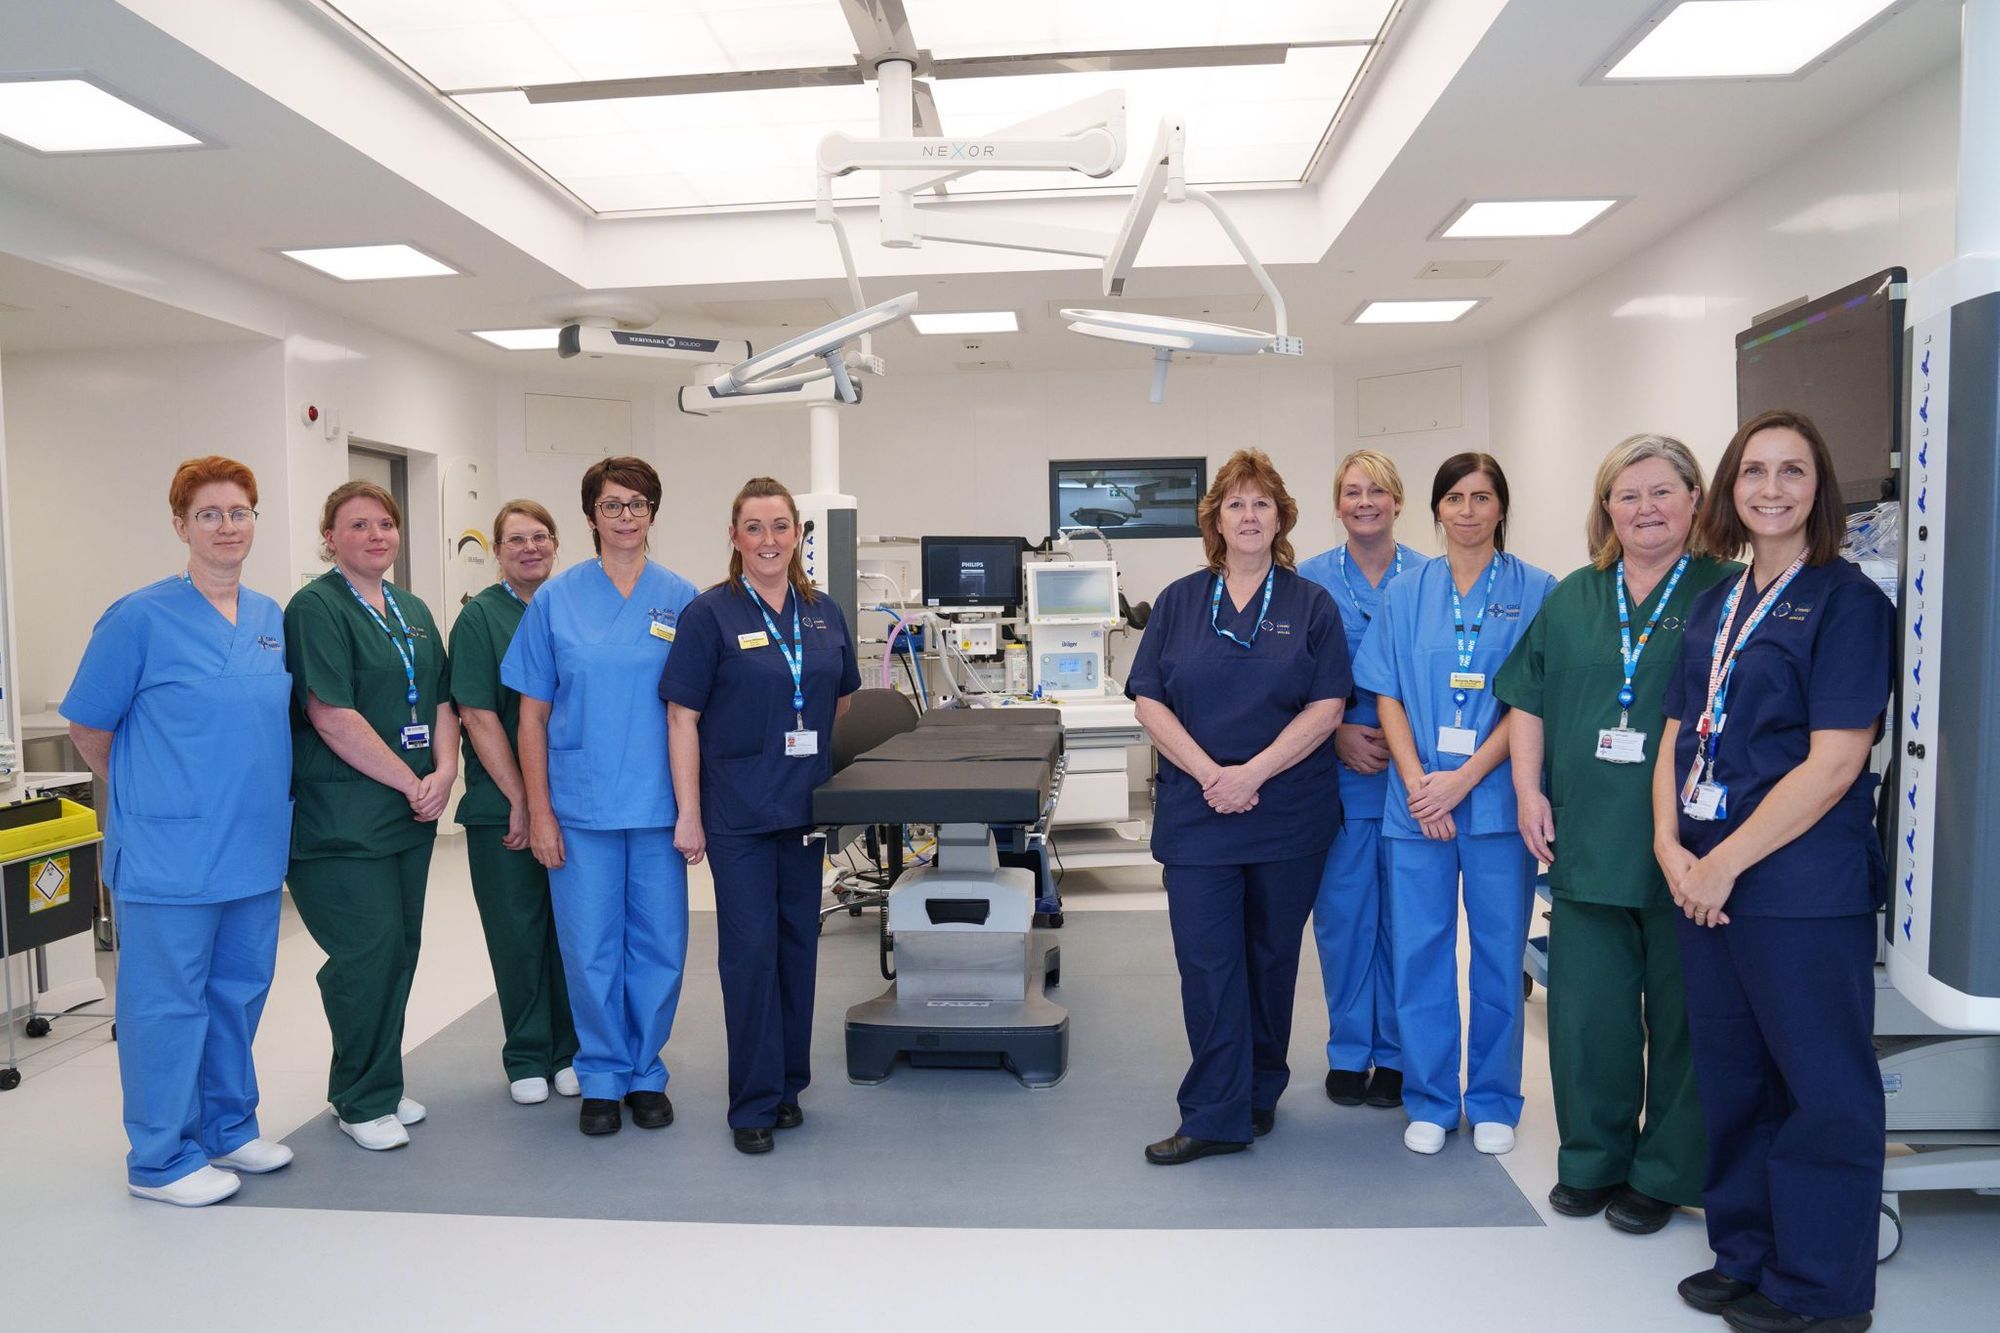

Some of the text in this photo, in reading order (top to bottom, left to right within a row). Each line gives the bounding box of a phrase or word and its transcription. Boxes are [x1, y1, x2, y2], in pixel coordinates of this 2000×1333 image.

[922, 142, 995, 160] NEXOR
[1655, 559, 1688, 614] NHS NHS NHS NHS
[1457, 639, 1465, 651] NHS
[1467, 640, 1476, 652] NHS
